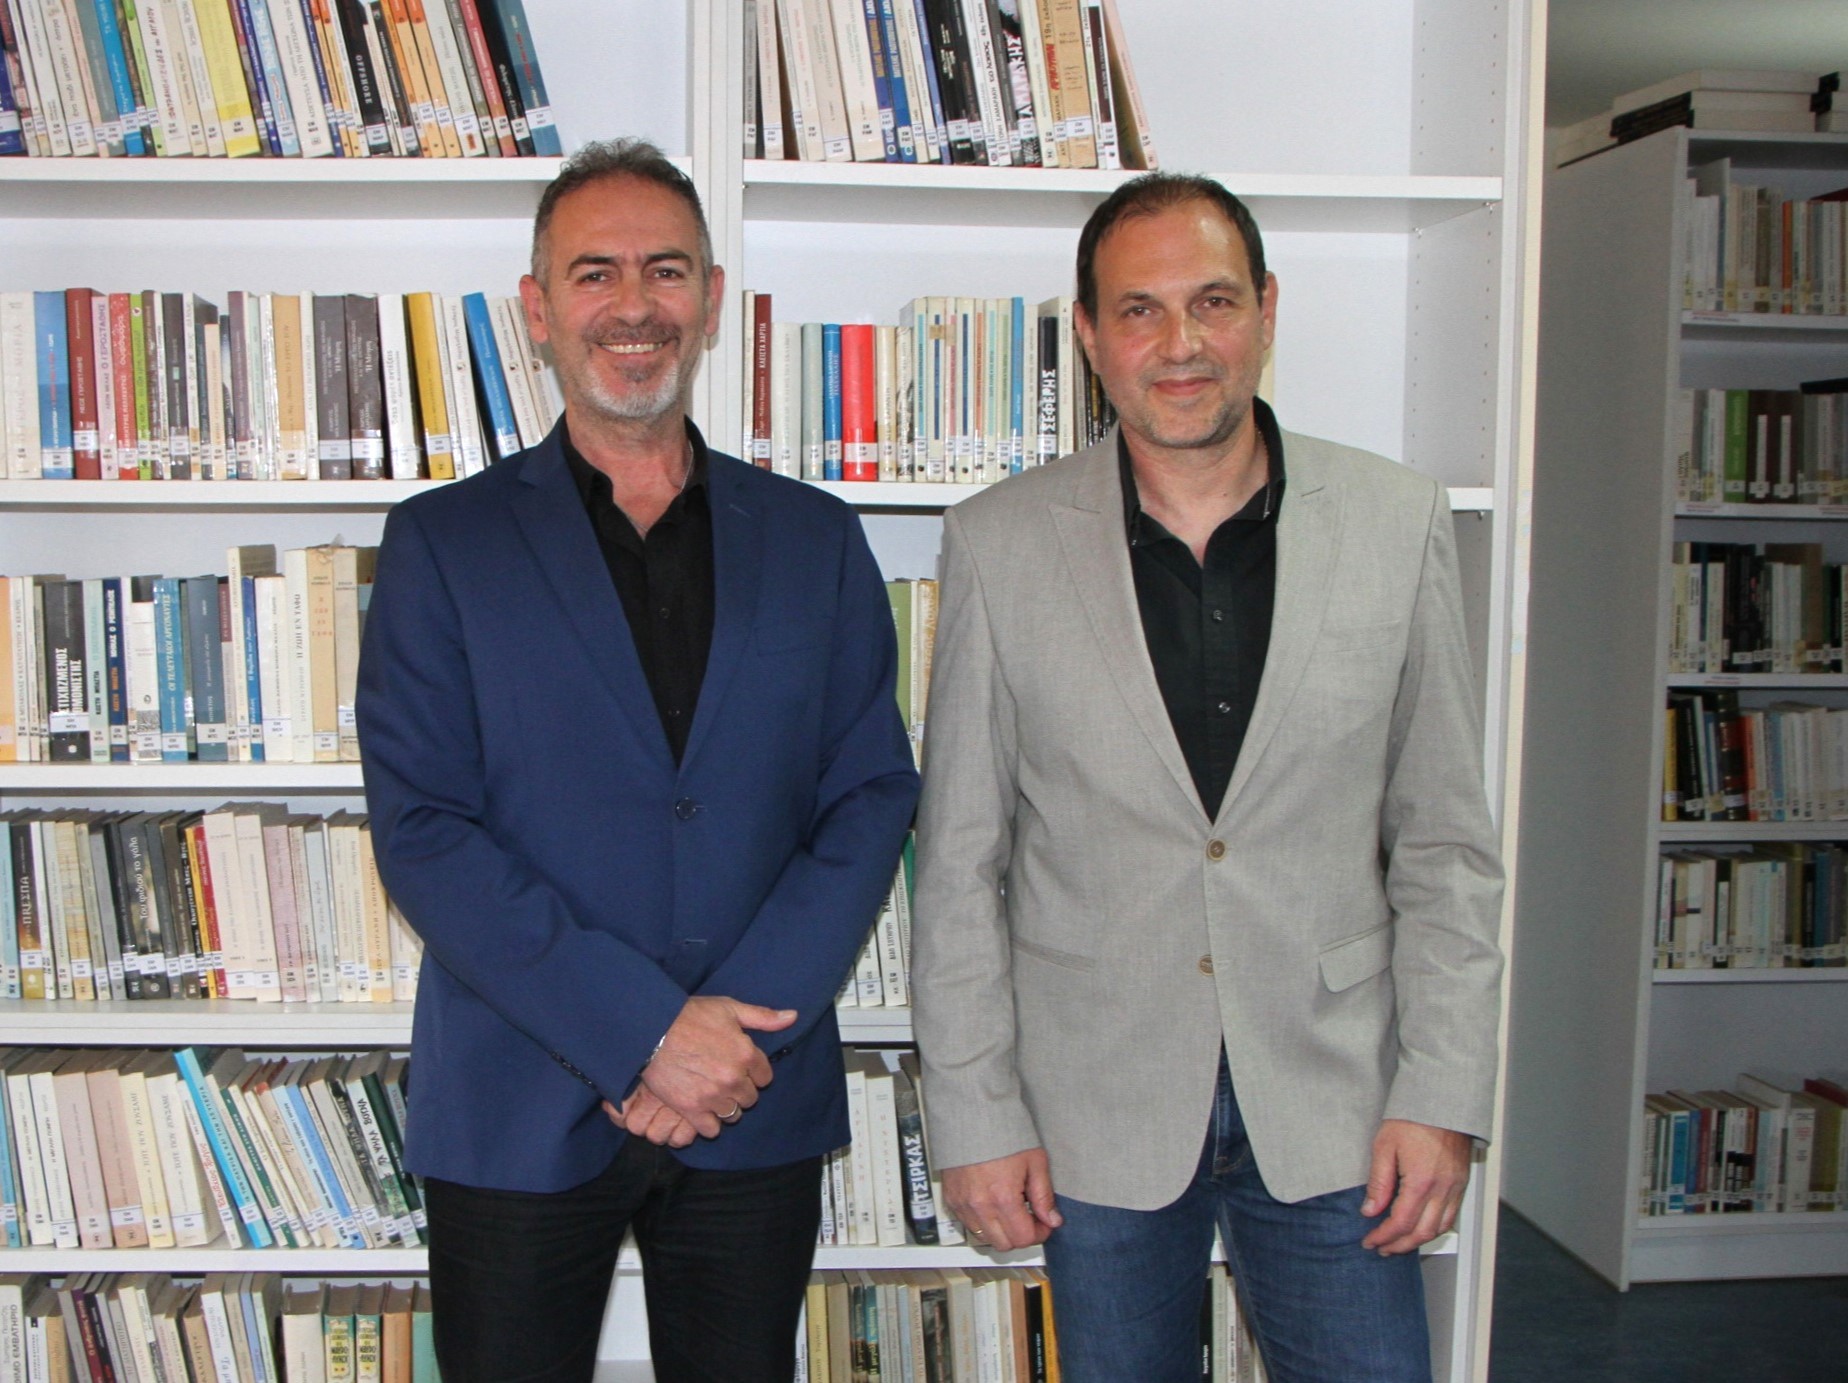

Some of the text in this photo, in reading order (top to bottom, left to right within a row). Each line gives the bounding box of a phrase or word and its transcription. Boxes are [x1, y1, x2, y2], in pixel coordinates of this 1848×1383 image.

[356, 55, 372, 104] OFFSHORE
[97, 304, 108, 360] ΓΕΡΟΣΤΑΘΗΣ
[1042, 369, 1056, 432] ΣΕΦΕΡΗΣ
[129, 837, 140, 858] γάλα
[134, 861, 141, 870] το
[134, 874, 148, 902] φιδιού
[186, 887, 199, 925] Οικογένεια
[907, 1134, 928, 1200] ΤΣΙΡΚΑΣ
